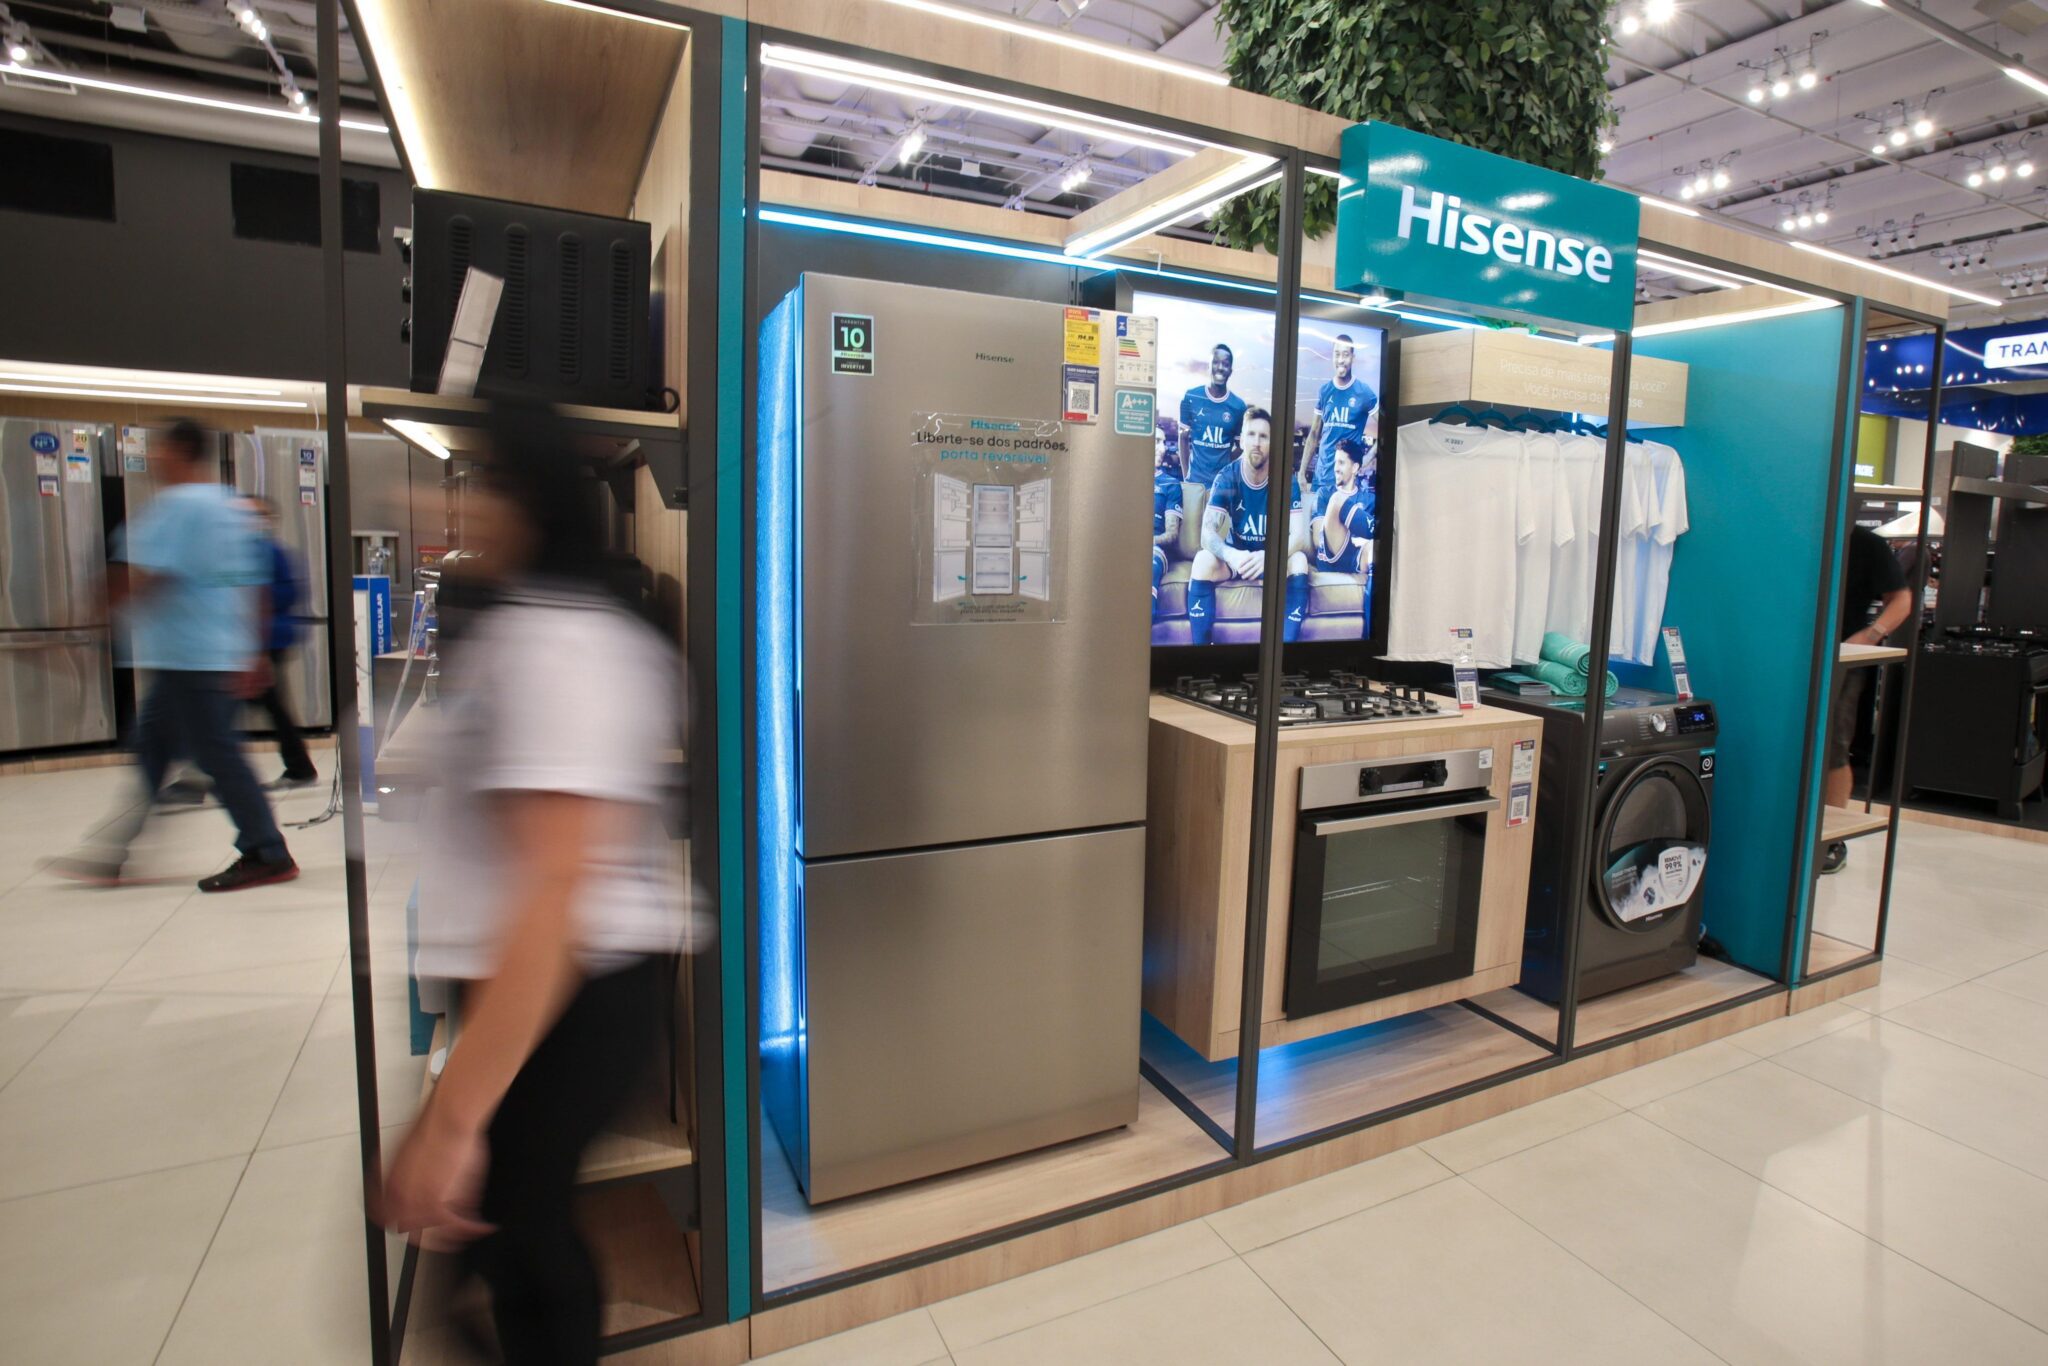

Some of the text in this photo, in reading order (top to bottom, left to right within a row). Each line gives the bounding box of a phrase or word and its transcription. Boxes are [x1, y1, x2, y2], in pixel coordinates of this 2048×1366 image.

[1398, 185, 1613, 284] Hisense
[840, 327, 865, 348] 10
[976, 352, 1014, 363] Hisense
[1500, 359, 1538, 376] Precisa
[1541, 366, 1555, 377] de
[1584, 372, 1611, 388] temp
[1552, 387, 1588, 402] precisa
[1588, 390, 1603, 402] de
[970, 419, 1020, 432] Hisense
[917, 432, 1069, 452] Liberte-se dos padrões,
[940, 450, 978, 461] porta
